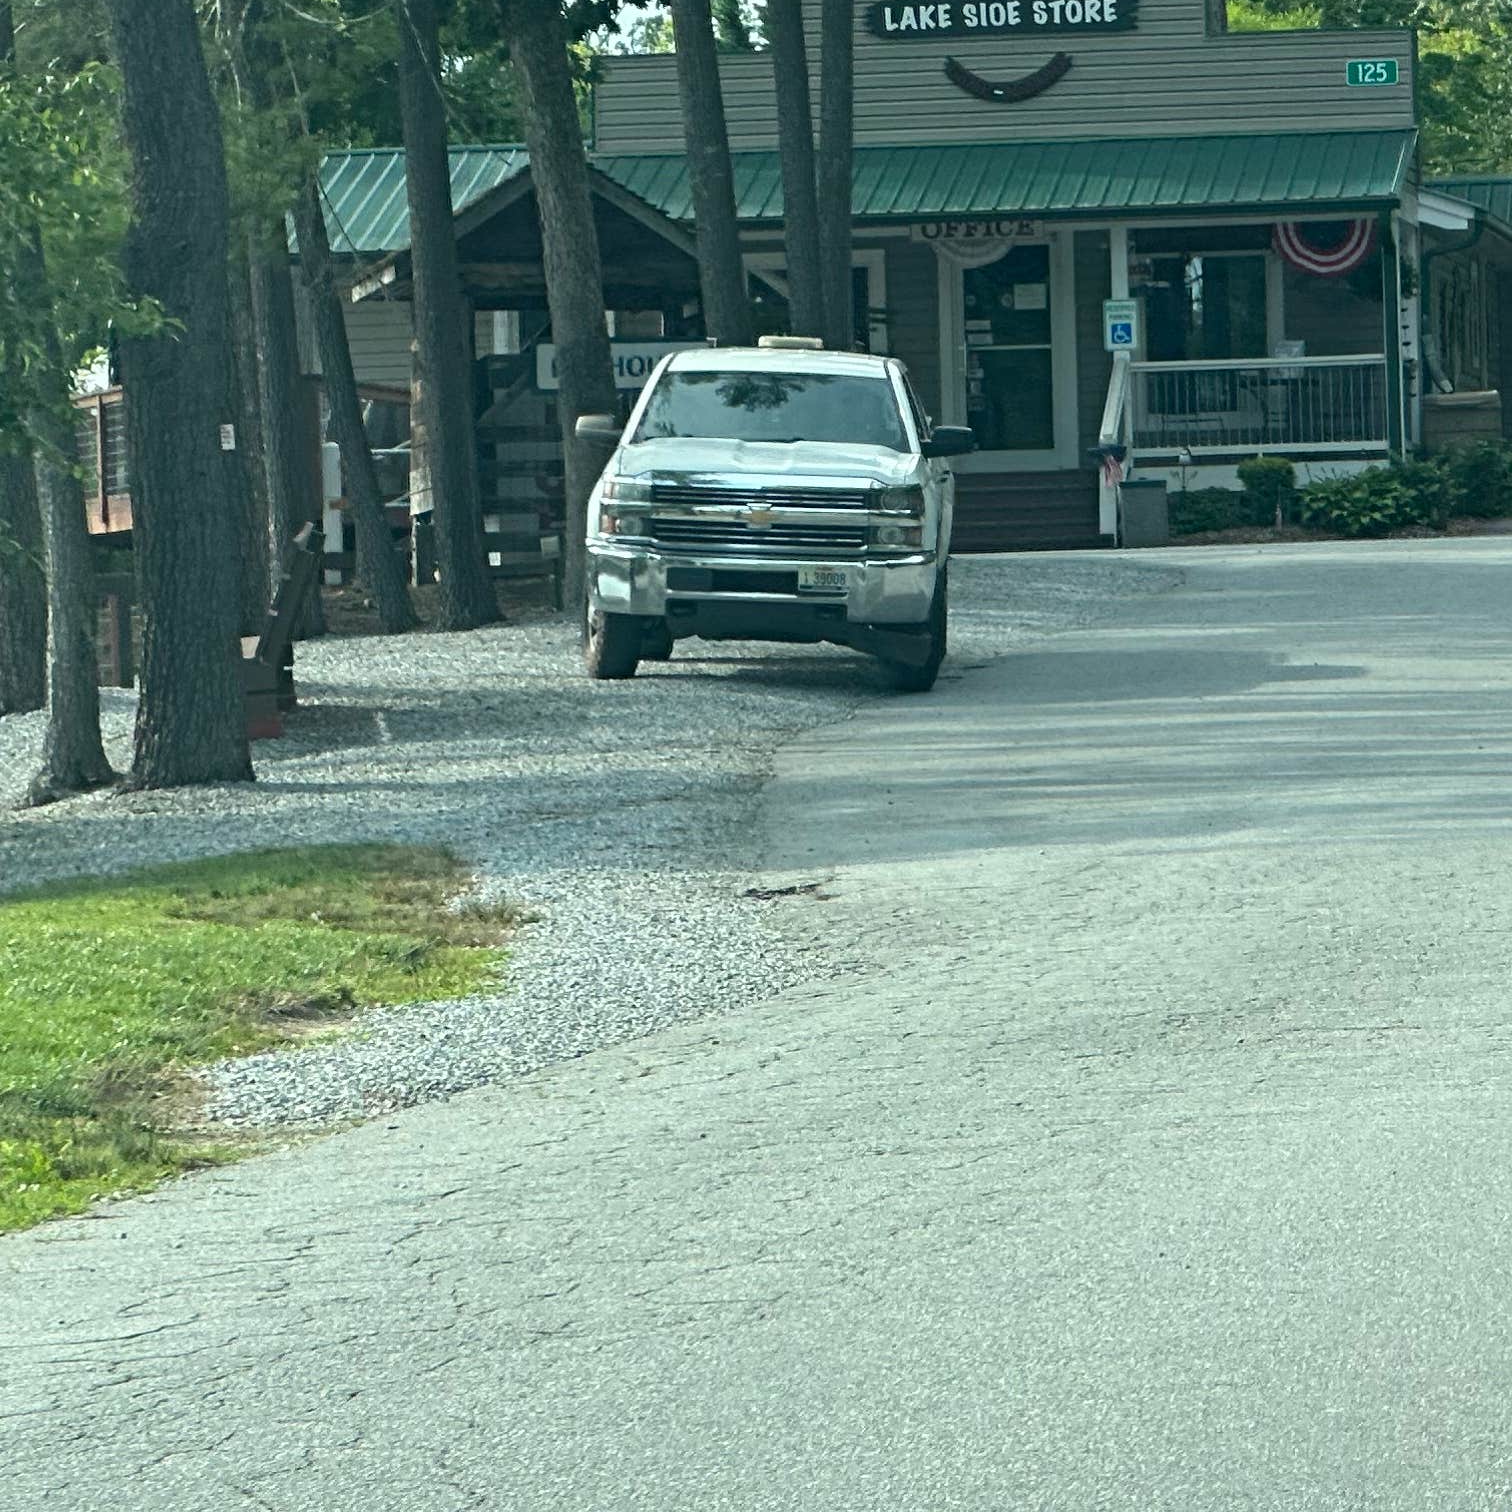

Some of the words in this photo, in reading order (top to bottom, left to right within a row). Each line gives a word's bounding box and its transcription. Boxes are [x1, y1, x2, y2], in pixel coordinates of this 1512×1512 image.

[883, 3, 952, 31] LAKE
[1357, 62, 1388, 83] 125
[921, 219, 1036, 239] OFFICE
